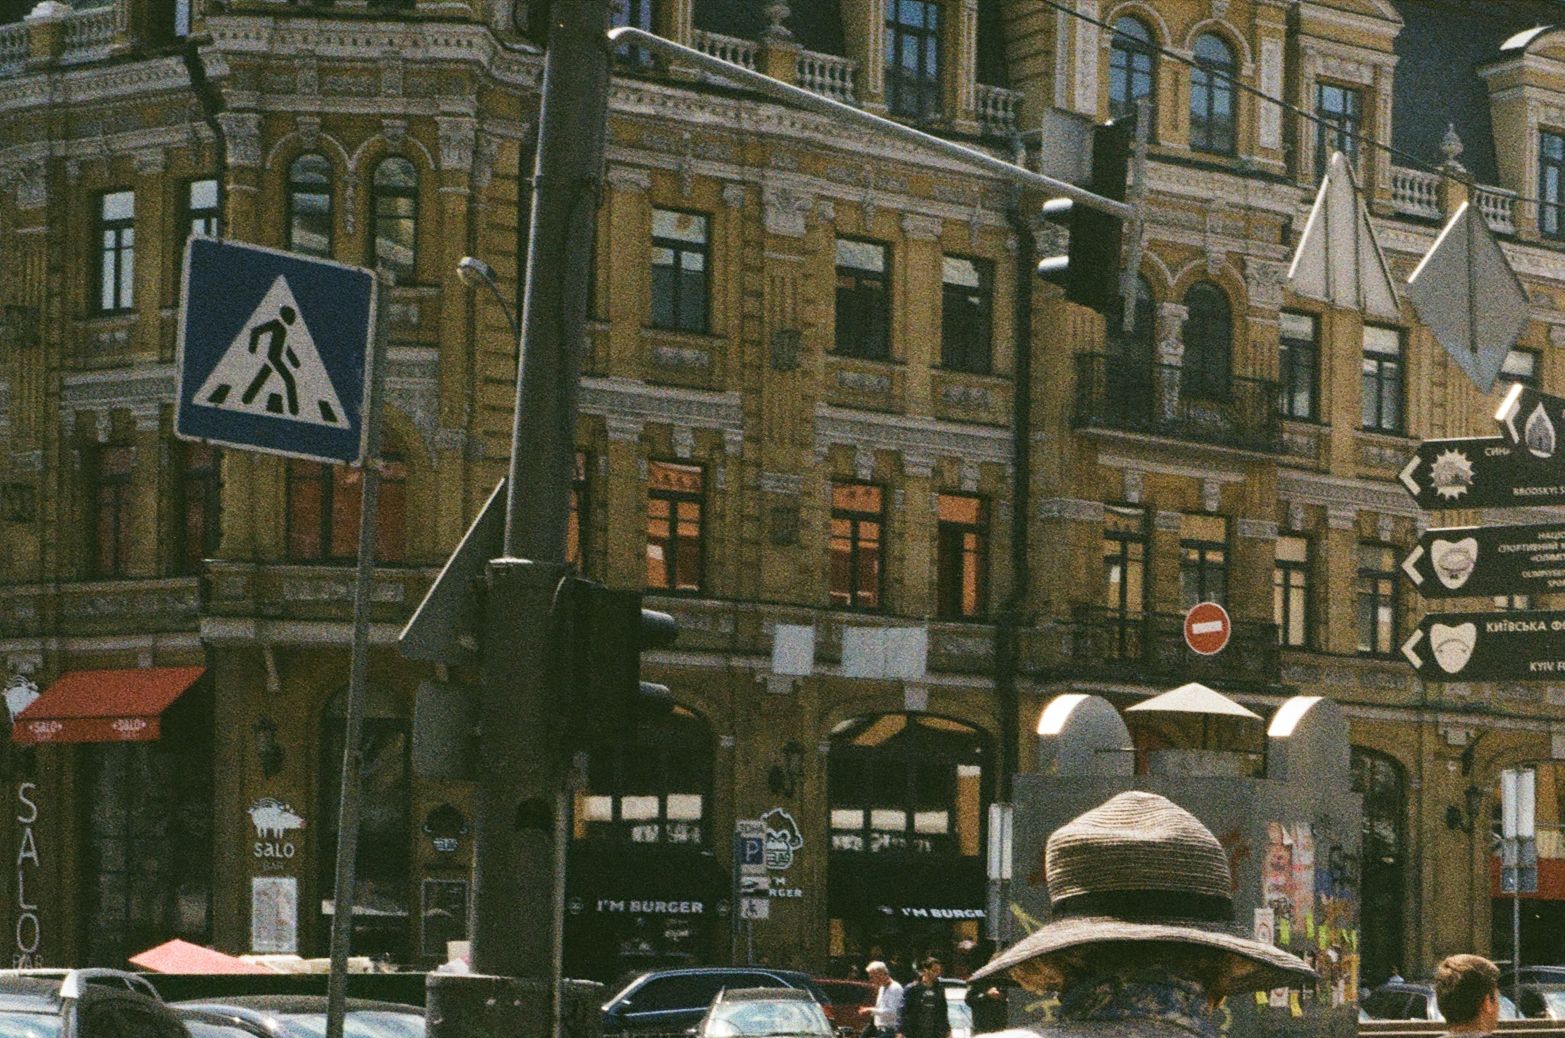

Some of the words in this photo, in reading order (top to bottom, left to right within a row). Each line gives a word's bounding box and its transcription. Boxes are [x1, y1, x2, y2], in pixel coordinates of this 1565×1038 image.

[1486, 620, 1547, 632] КИЇВСЬКА
[1530, 662, 1554, 671] KYIV
[17, 782, 39, 953] SALO
[597, 901, 624, 912] I'M
[630, 901, 703, 913] BURGER
